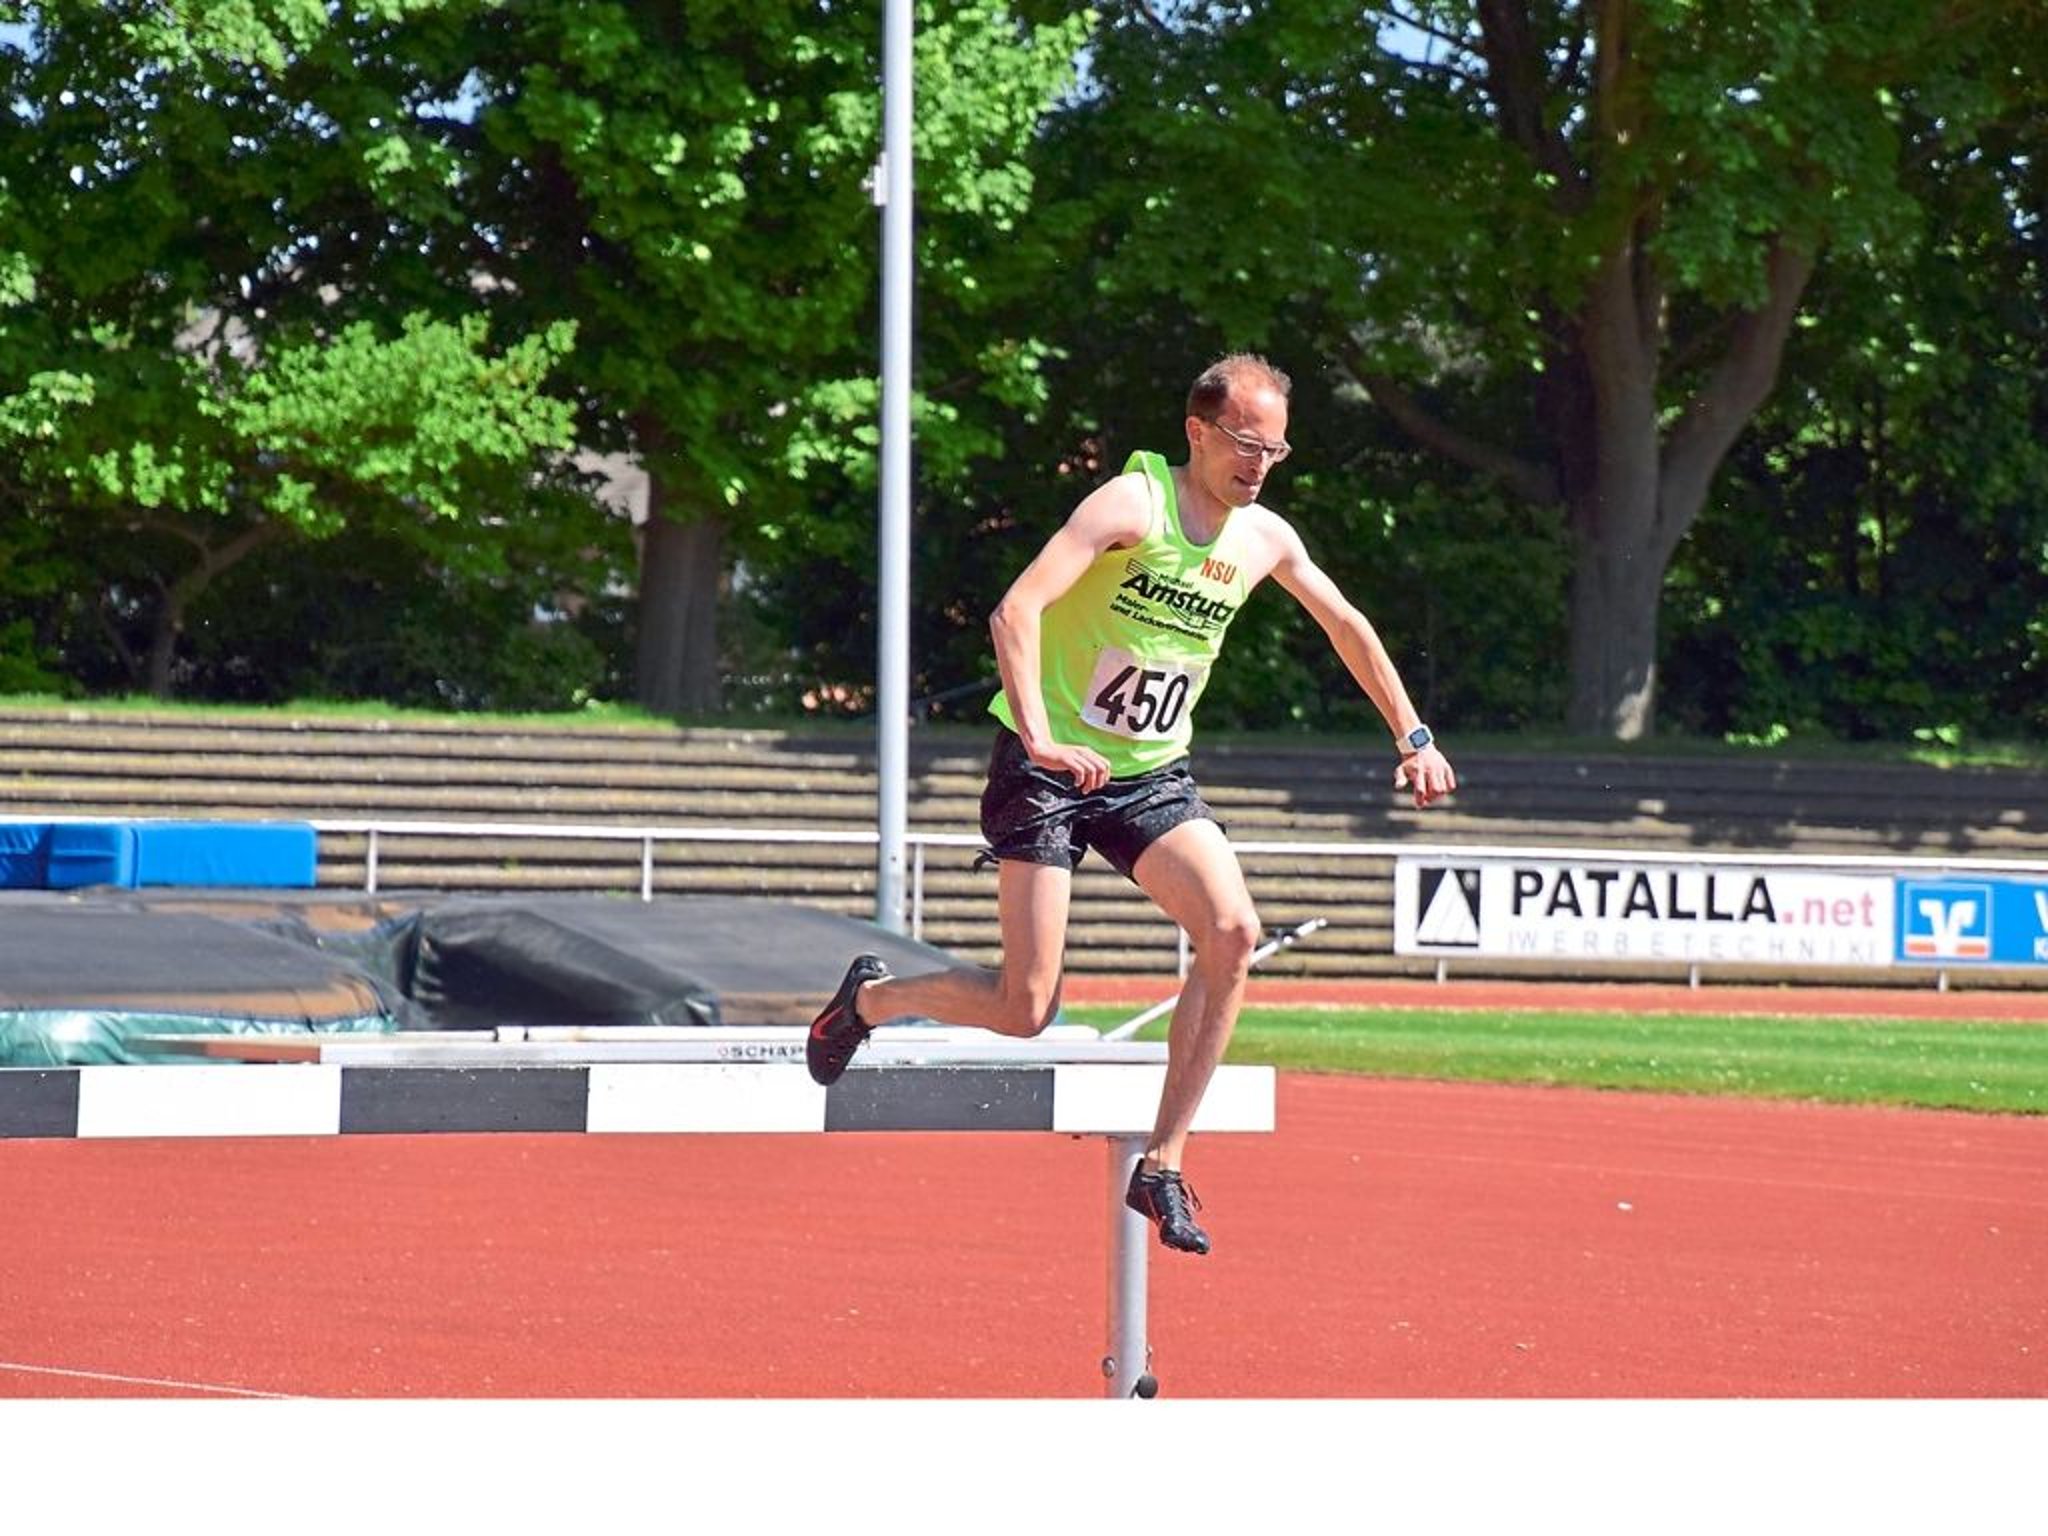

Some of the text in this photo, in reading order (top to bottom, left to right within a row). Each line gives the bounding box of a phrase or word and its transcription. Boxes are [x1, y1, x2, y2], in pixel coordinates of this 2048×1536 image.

[1120, 573, 1236, 623] Amstutz
[1201, 558, 1237, 585] NSU
[1094, 665, 1189, 733] 450
[1512, 869, 1874, 927] PATALLA.net
